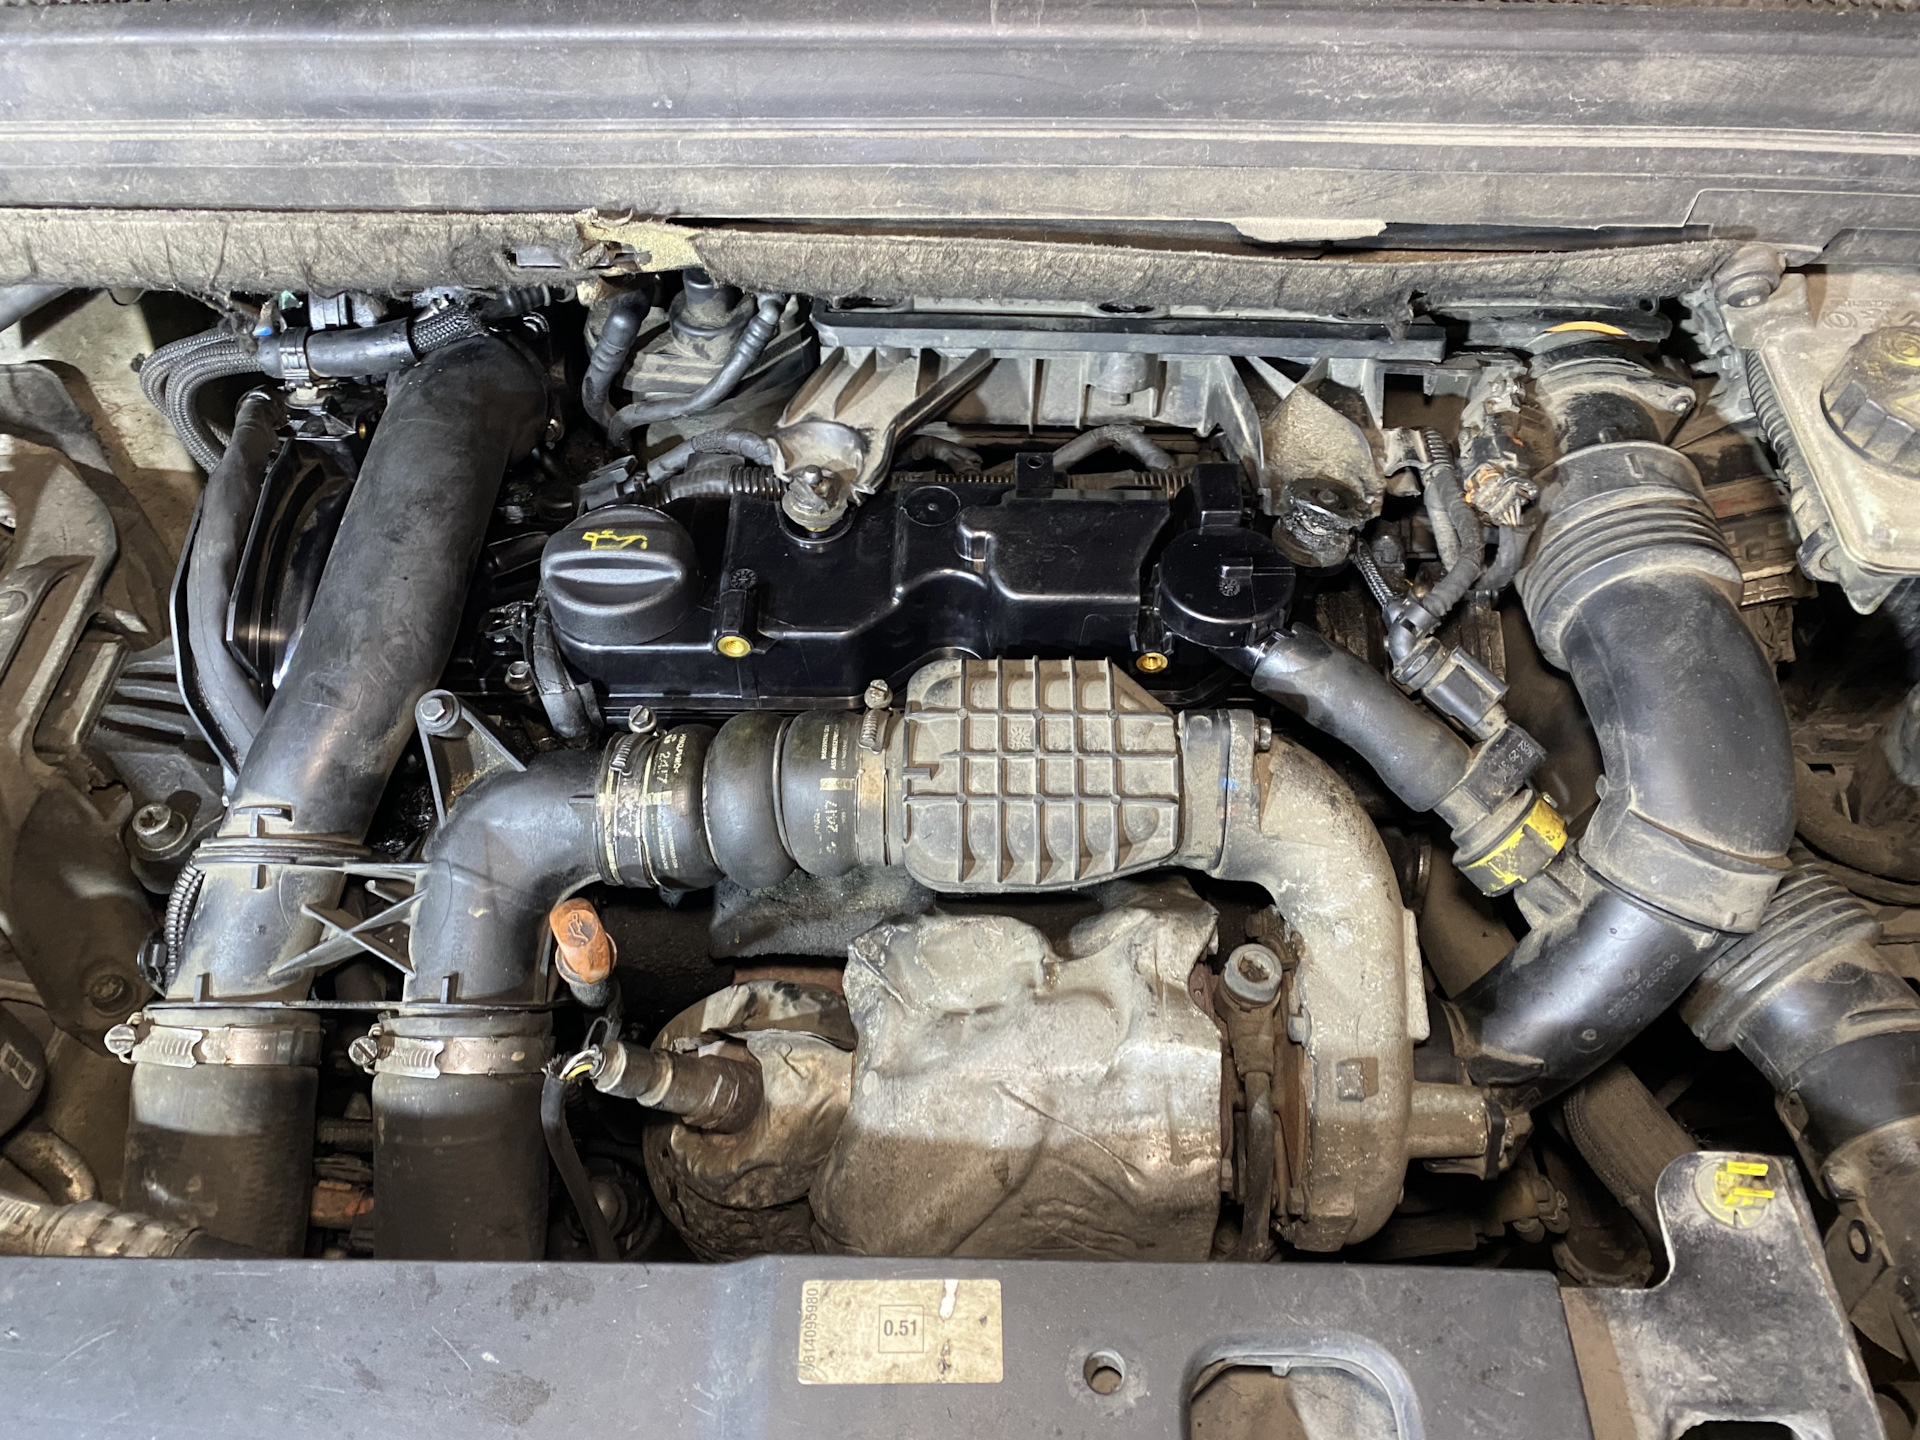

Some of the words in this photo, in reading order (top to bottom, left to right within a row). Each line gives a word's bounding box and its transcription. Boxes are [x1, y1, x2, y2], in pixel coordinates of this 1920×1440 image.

[657, 750, 671, 784] 2417
[824, 800, 838, 834] 2417
[884, 1319, 917, 1336] 0.51
